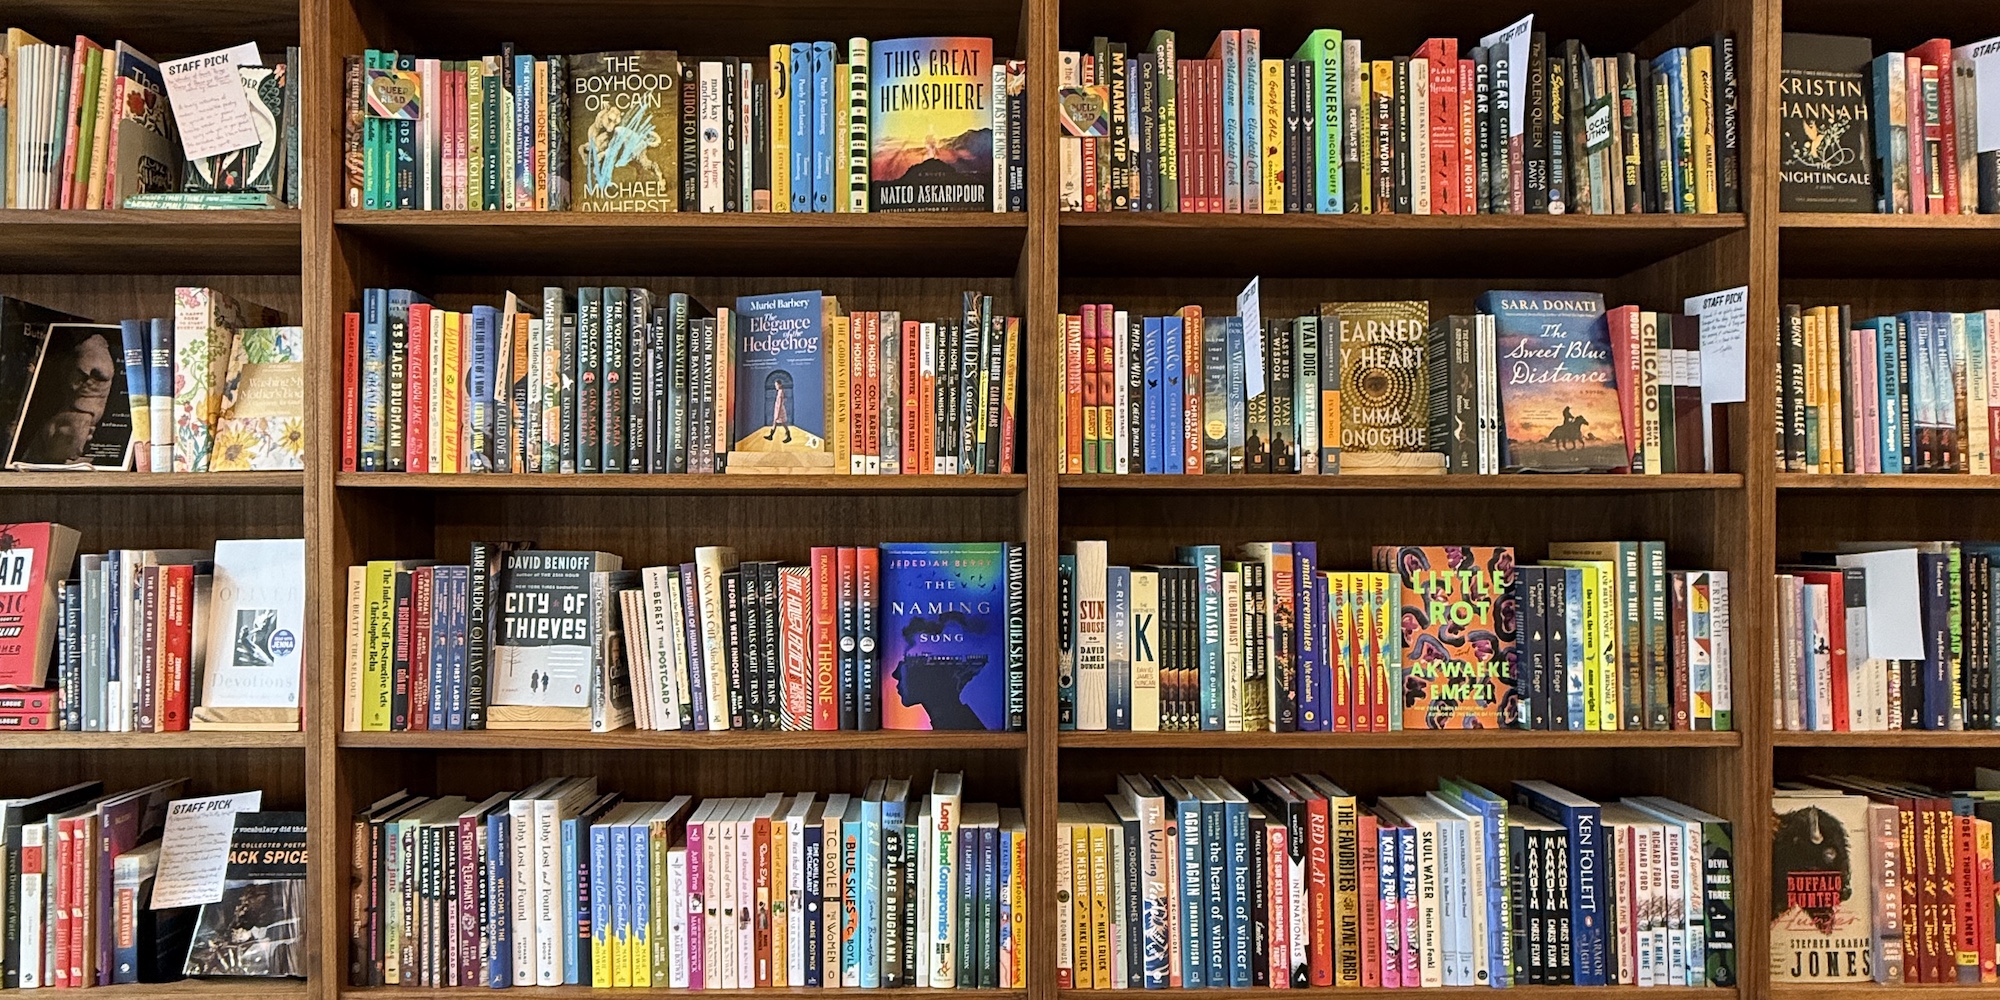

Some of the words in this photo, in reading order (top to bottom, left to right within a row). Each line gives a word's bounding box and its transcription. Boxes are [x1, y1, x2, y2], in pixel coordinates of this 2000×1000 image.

[169, 59, 201, 76] STAFF
[205, 54, 229, 68] PICK
[604, 57, 640, 72] THE
[885, 52, 921, 77] THIS
[929, 50, 980, 75] GREAT
[1112, 52, 1124, 76] MY
[1431, 67, 1456, 75] PLAIN
[576, 74, 672, 93] BOYHOOD
[1324, 59, 1337, 128] SINNERS!
[1430, 84, 1457, 94] Heroines
[1477, 64, 1488, 113] CLEAR
[1497, 60, 1508, 110] CLEAR
[1780, 78, 1861, 97] KRISTIN
[585, 95, 610, 111] OF
[616, 93, 661, 108] CAIN
[881, 84, 984, 111] HEMISPHERE
[1114, 80, 1125, 123] NAME
[1925, 84, 1938, 121] JUJA
[1464, 100, 1472, 145] TALKING
[1780, 104, 1869, 120] HANNAH
[1116, 126, 1123, 135] IS
[1114, 136, 1125, 163] YIP
[1465, 150, 1472, 159] AT
[583, 182, 667, 198] MICHAEL
[1465, 161, 1473, 199] NIGHT
[1780, 172, 1870, 185] NIGHTINGALE
[582, 200, 670, 211] AMHERST
[880, 186, 914, 204] MATEO
[917, 186, 984, 203] ASKARIPOUR
[751, 300, 776, 310] Muriel
[778, 299, 809, 310] Barbery
[1502, 300, 1538, 311] SARA
[1543, 300, 1596, 312] DONATI
[1703, 297, 1723, 309] STAFF
[1725, 292, 1744, 305] PICK
[545, 298, 554, 330] WHEN
[751, 316, 811, 333] Elegance
[392, 324, 403, 338] 33
[1340, 319, 1422, 342] EARNED
[1541, 323, 1567, 338] The
[1883, 323, 1894, 348] CARL
[545, 335, 554, 352] WE
[590, 322, 598, 368] VOLCANO
[743, 336, 817, 354] Hedgehog
[1504, 342, 1560, 359] Sweet
[1566, 342, 1607, 359] Blue
[392, 342, 402, 378] PLACE
[1361, 347, 1424, 369] HEART
[1643, 323, 1656, 413] CHICAGO
[544, 355, 554, 389] GROW
[1510, 362, 1607, 385] Distance
[1884, 352, 1896, 396] HIAASEN
[544, 393, 554, 408] UP
[391, 381, 403, 447] BRUGMANN
[1352, 406, 1402, 424] EMMA
[1341, 428, 1426, 446] ONOGHUE
[474, 546, 485, 572] MARIE
[508, 557, 541, 569] DAVID
[545, 557, 589, 569] BENIOFF
[891, 560, 949, 568] JEDEDIAH
[955, 560, 991, 568] BERRY
[1204, 554, 1216, 583] MAYA
[1628, 551, 1637, 576] FAGIN
[843, 565, 851, 596] FLYNN
[925, 581, 956, 589] THE
[1009, 546, 1022, 614] MADWOMAN
[1412, 571, 1505, 595] LITTLE
[472, 575, 484, 623] BENEDICT
[505, 593, 548, 614] CITY
[563, 593, 587, 614] OF
[653, 590, 664, 632] BEREST
[892, 602, 990, 614] NAMING
[1081, 601, 1104, 620] SUN
[1628, 597, 1637, 621] THIEF
[1204, 597, 1217, 645] NATASHA
[1430, 601, 1490, 624] ROT
[505, 618, 586, 639] THIEVES
[920, 634, 963, 642] SONG
[1081, 622, 1104, 633] HOUSE
[1136, 614, 1153, 661] K
[271, 641, 293, 649] JENNA
[1010, 618, 1022, 668] CHELSEA
[658, 652, 671, 704] POSTCARD
[819, 641, 832, 705] THRONE
[1411, 663, 1510, 678] AKWAEKE
[1010, 671, 1023, 713] BIEKER
[1431, 685, 1493, 700] EMEZI
[173, 802, 204, 815] STAFF
[207, 800, 232, 811] PICK
[938, 801, 952, 831] Long
[1339, 803, 1354, 825] THE
[518, 815, 526, 841] Libby
[1185, 812, 1198, 845] AGAIN
[1311, 812, 1324, 844] RED
[1578, 815, 1592, 845] KEN
[888, 837, 897, 851] 33
[939, 832, 952, 865] Island
[1236, 842, 1247, 863] the
[1423, 832, 1432, 863] SKULL
[229, 851, 259, 864] ACK
[263, 850, 308, 864] SPICE
[517, 846, 526, 867] Lost
[846, 842, 856, 873] BLUE
[1312, 846, 1325, 887] CLAY
[1339, 829, 1355, 892] FAVORITES
[1709, 859, 1728, 868] DEVIL
[1885, 842, 1895, 887] PEACH
[887, 856, 897, 893] PLACE
[1186, 862, 1199, 895] AGAIN
[1235, 866, 1248, 902] heart
[1424, 864, 1434, 900] WATER
[1528, 837, 1538, 910] MAMMOTH
[1578, 849, 1595, 912] FOLLETT
[1707, 875, 1730, 884] MAKES
[1788, 877, 1841, 890] BUFFALO
[518, 887, 527, 921] Found
[847, 877, 856, 914] SKIES
[938, 866, 952, 940] Compromise
[1708, 890, 1730, 899] THREE
[1788, 892, 1840, 907] HUNTER
[1236, 906, 1248, 922] of
[1886, 893, 1896, 928] SEED
[886, 898, 897, 962] BRUGMANN
[1342, 915, 1355, 947] LAYNE
[1236, 924, 1249, 969] winter
[1791, 939, 1830, 948] STEPHEN
[1343, 950, 1356, 981] FARGO
[1791, 951, 1870, 977] JONES
